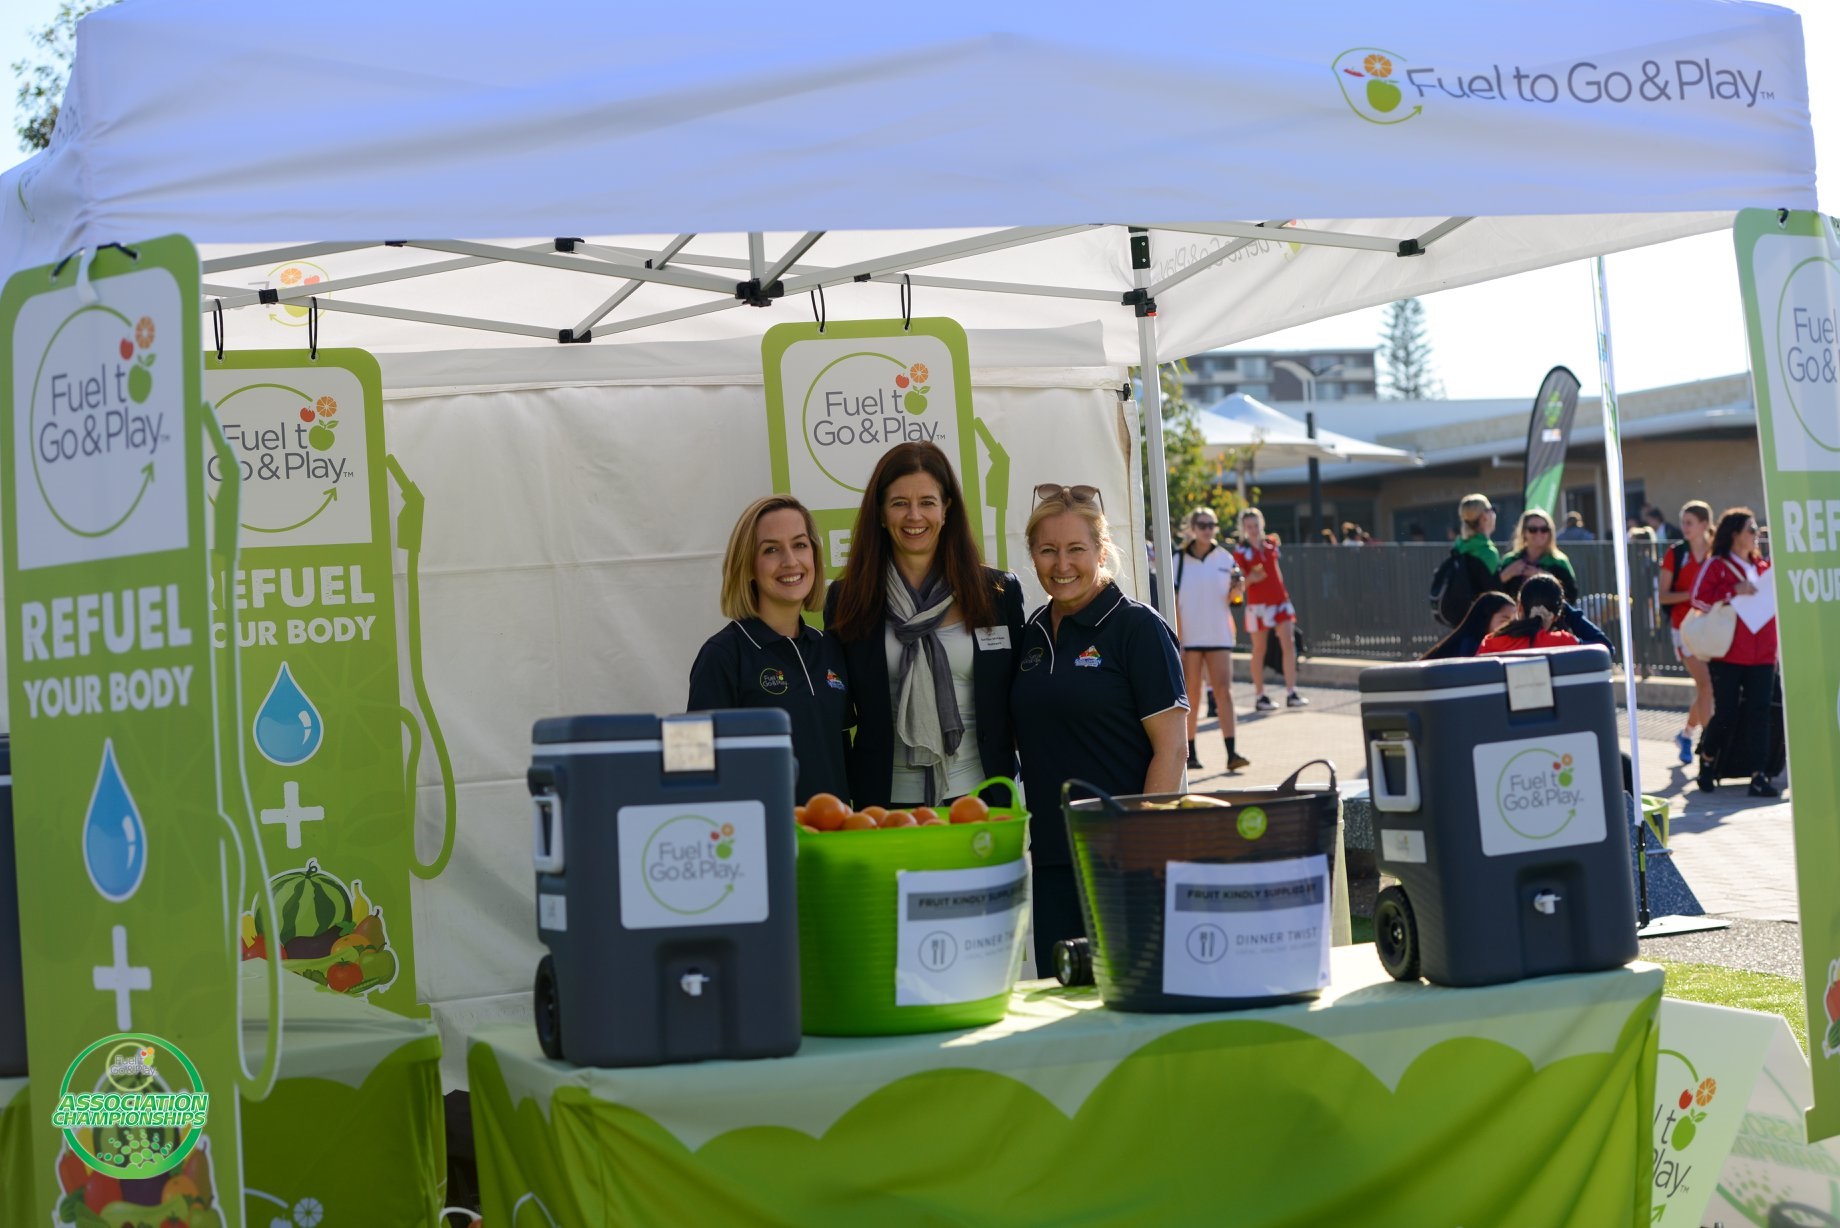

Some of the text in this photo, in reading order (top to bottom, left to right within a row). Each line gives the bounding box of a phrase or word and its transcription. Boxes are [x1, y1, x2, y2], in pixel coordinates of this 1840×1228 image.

[1406, 65, 1506, 99] Fuel
[1513, 65, 1559, 103] to
[1793, 307, 1839, 344] Fuel
[51, 365, 109, 416] Fuel
[825, 388, 884, 417] Fuel
[222, 422, 286, 451] Fuel
[22, 583, 193, 662] REFUEL
[212, 614, 376, 650] OUR BODY
[23, 666, 194, 719] YOUR BODY
[1510, 771, 1547, 792] Fuel
[659, 840, 702, 861] Fuel
[918, 896, 950, 908] FRUIT
[1187, 889, 1220, 900] FRUIT
[964, 933, 1003, 951] DINNER
[1235, 926, 1318, 947] DINNER TWIST
